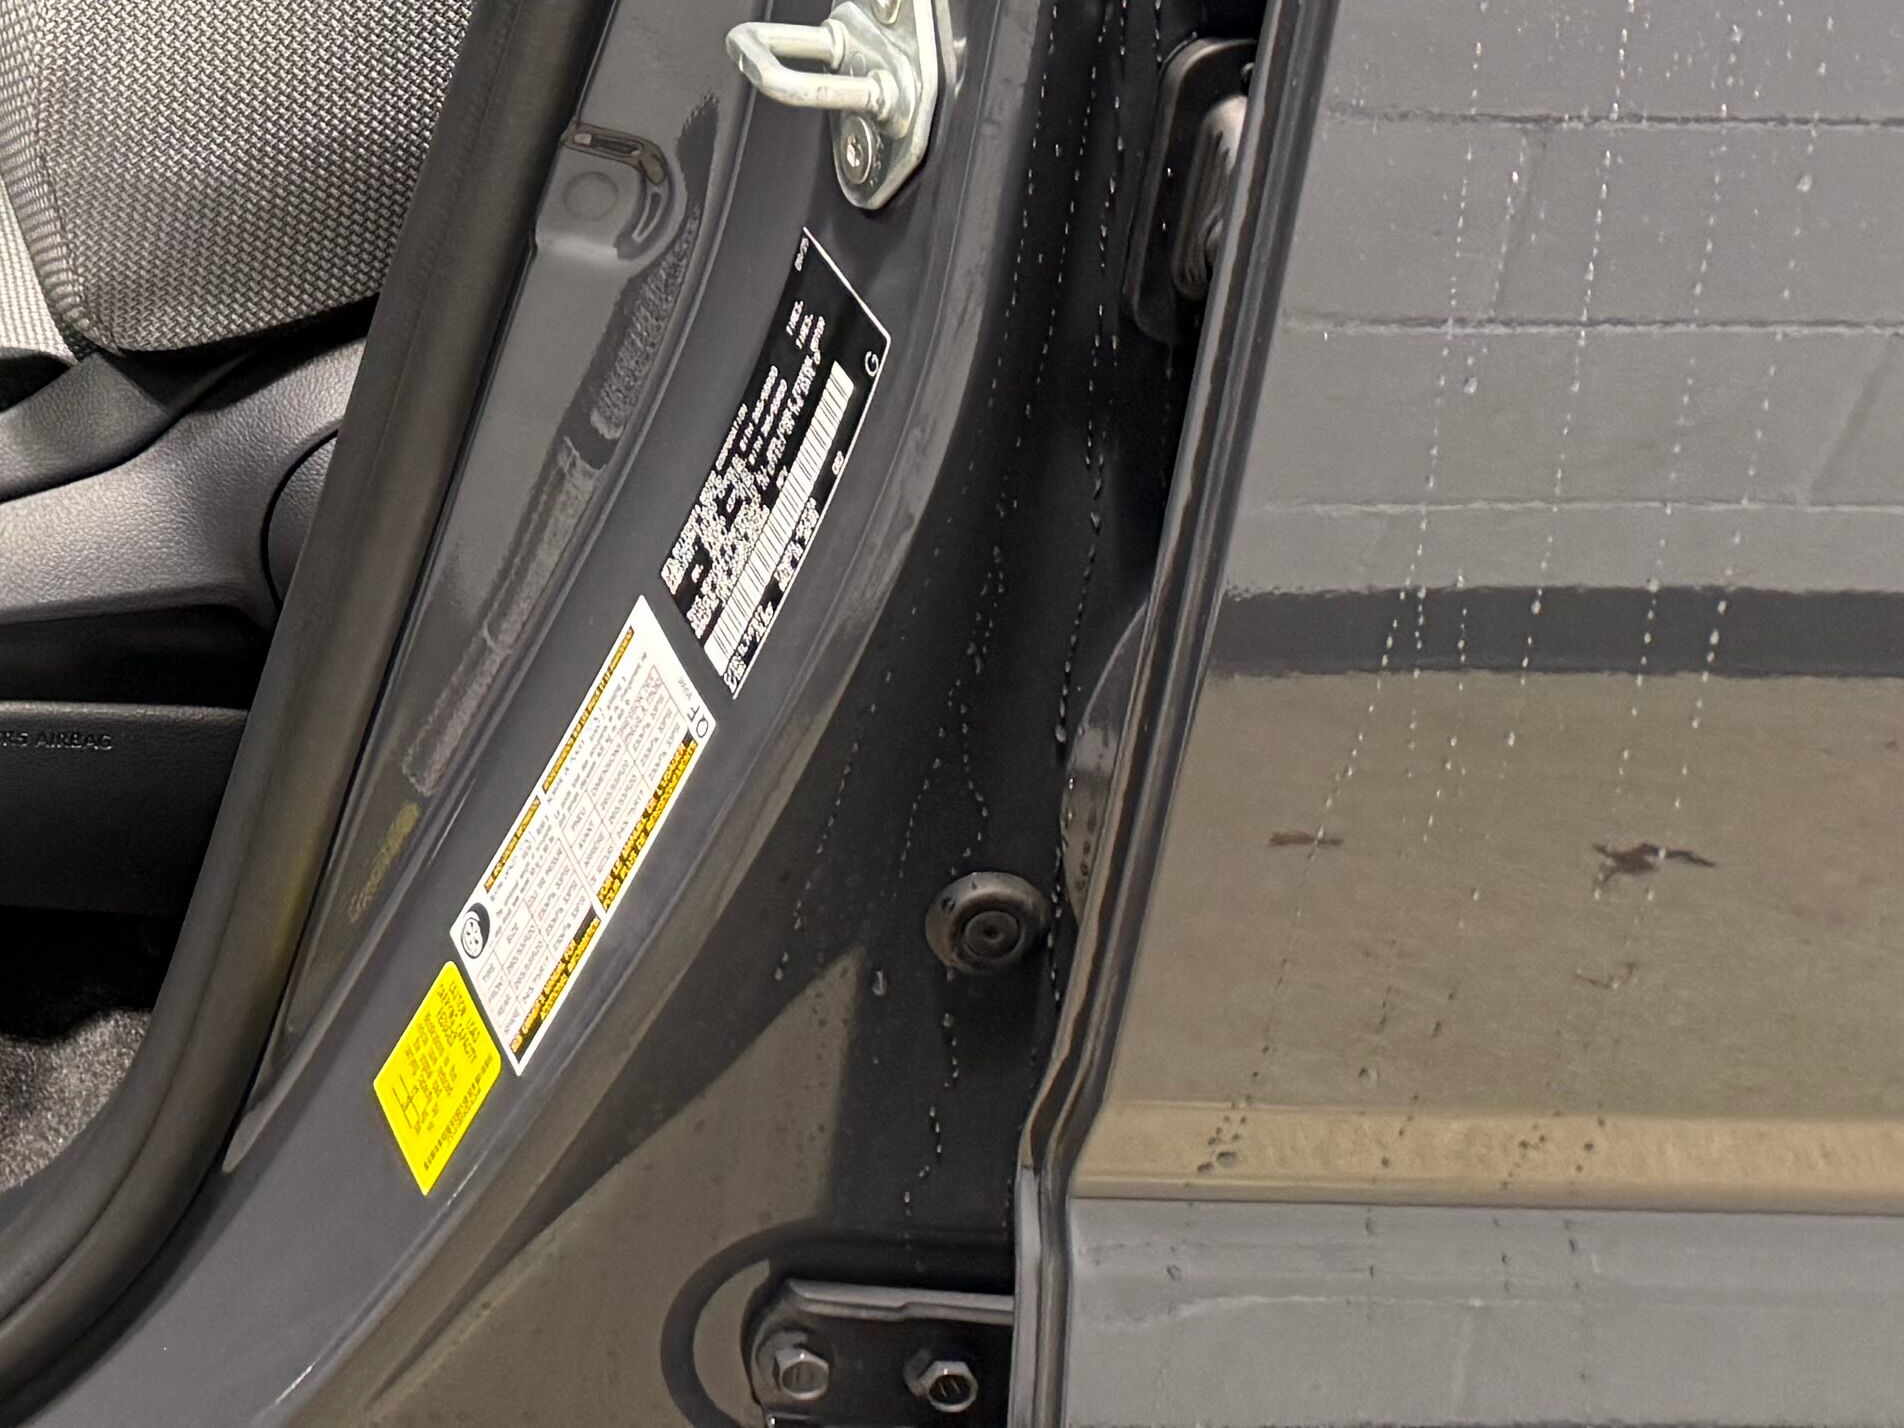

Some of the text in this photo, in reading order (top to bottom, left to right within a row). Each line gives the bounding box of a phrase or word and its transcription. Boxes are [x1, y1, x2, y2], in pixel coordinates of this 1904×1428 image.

[864, 350, 879, 376] G
[687, 705, 708, 739] QF
[34, 730, 113, 751] AIRBAG
